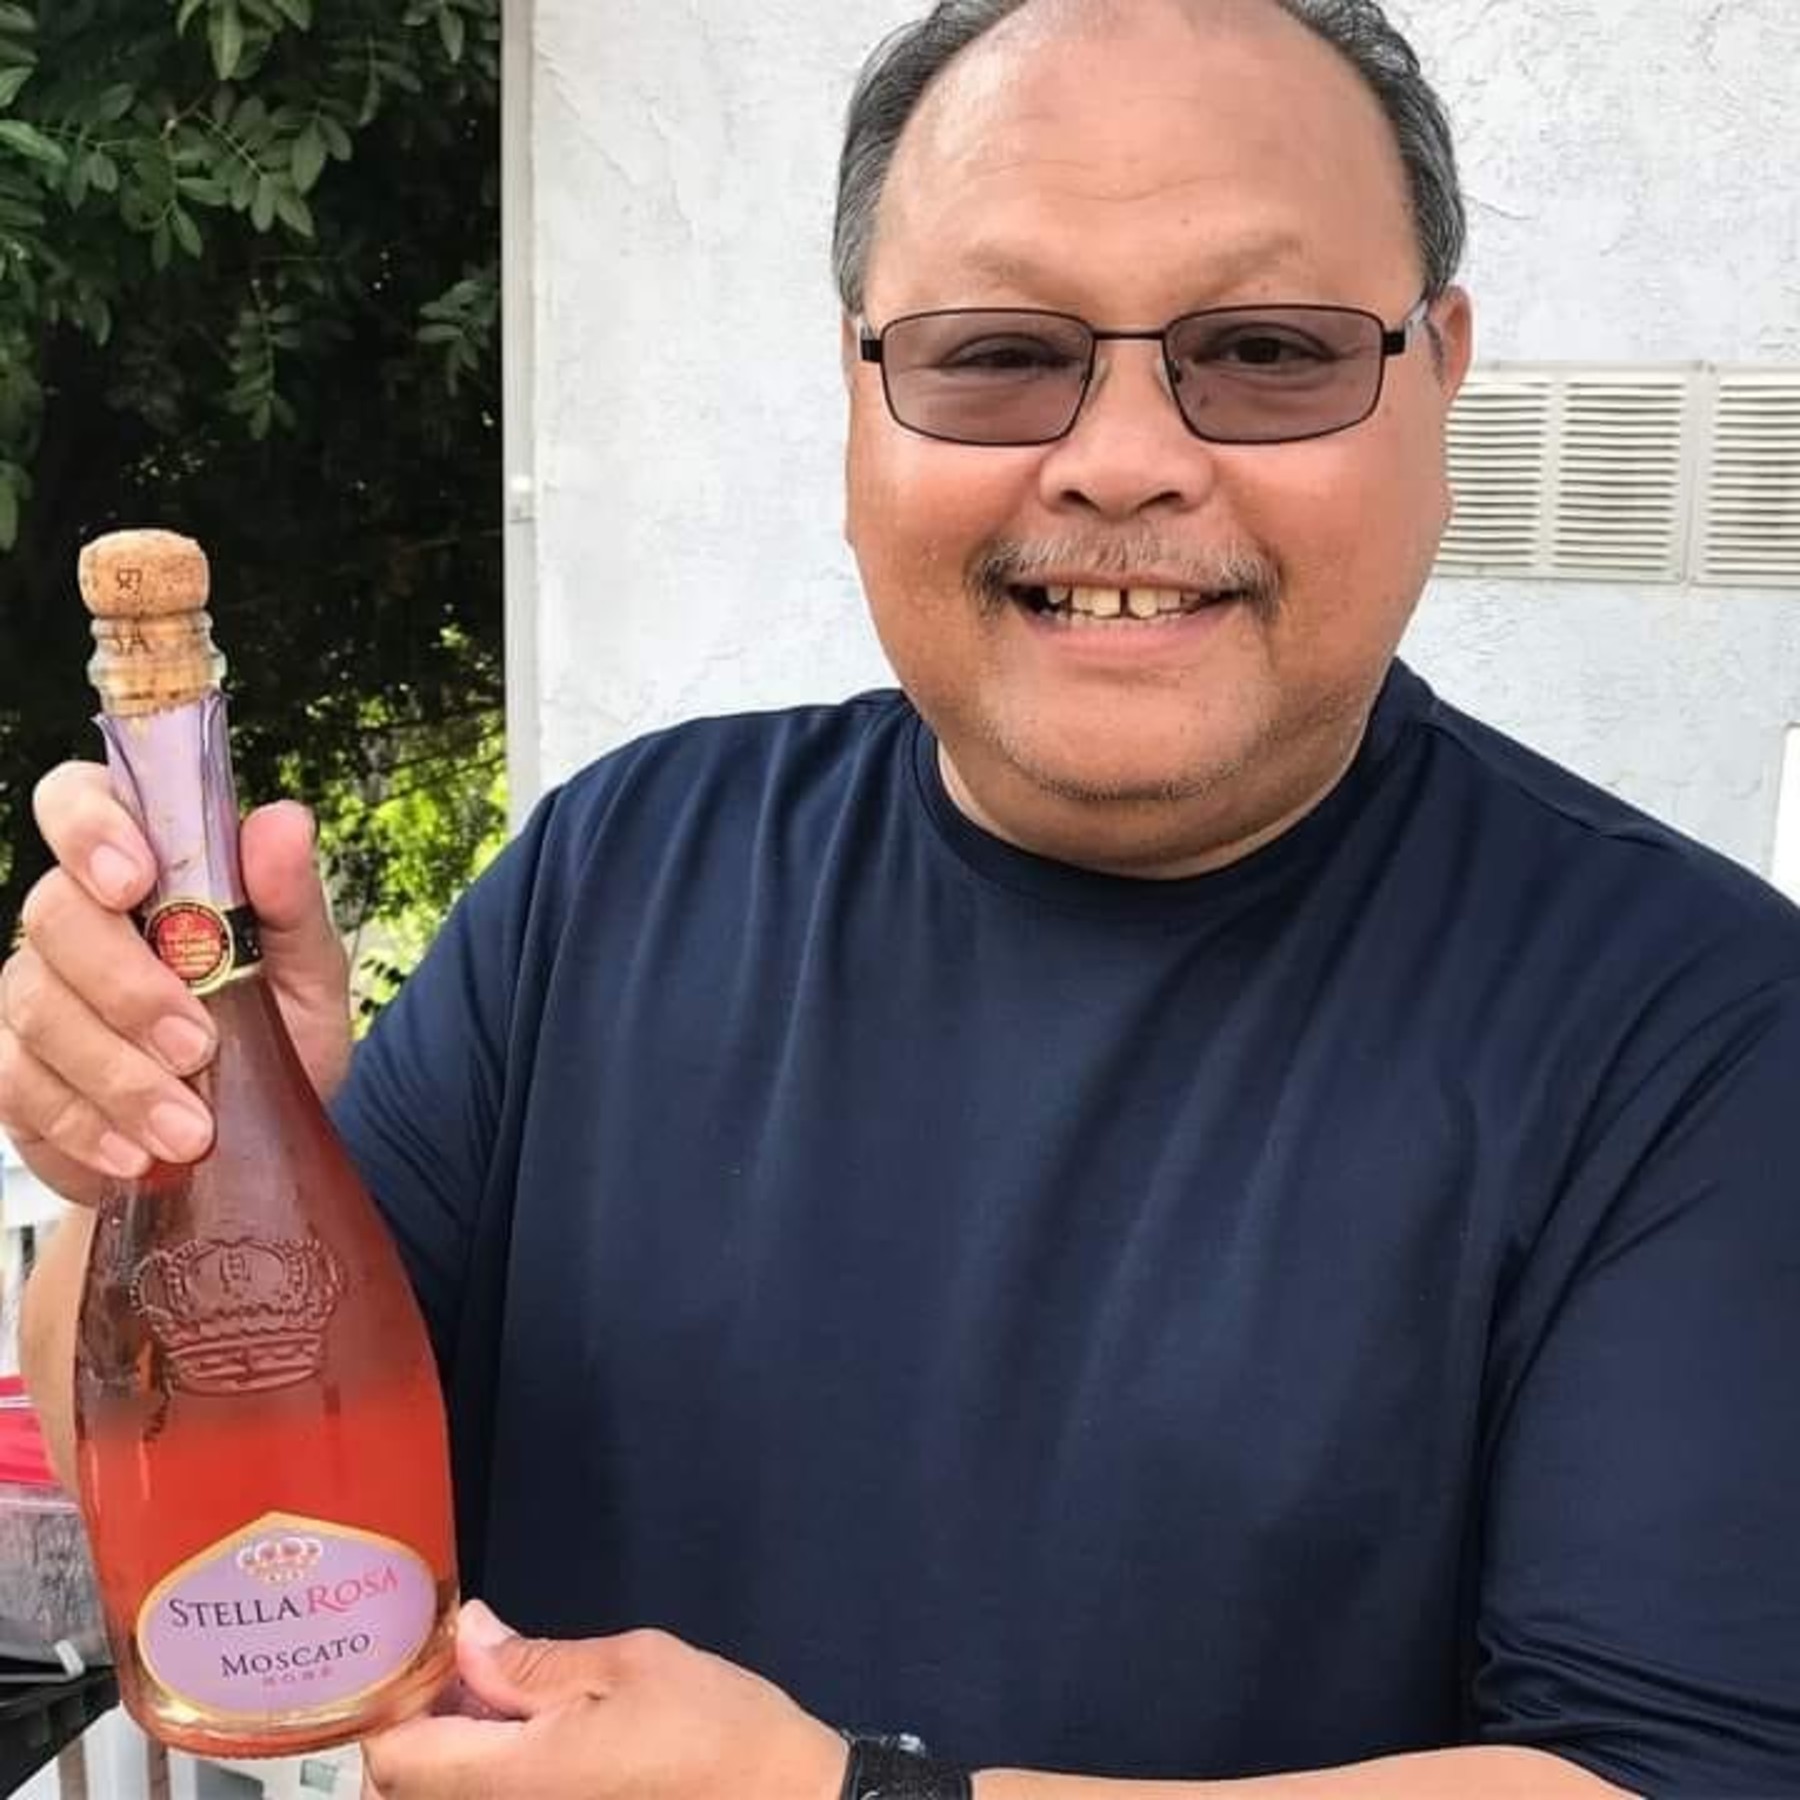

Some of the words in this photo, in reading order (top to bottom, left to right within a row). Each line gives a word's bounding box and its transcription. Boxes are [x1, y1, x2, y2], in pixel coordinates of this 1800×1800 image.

[168, 1595, 302, 1629] STELLA
[306, 1565, 400, 1614] ROSA
[220, 1632, 371, 1679] MOSCATO
